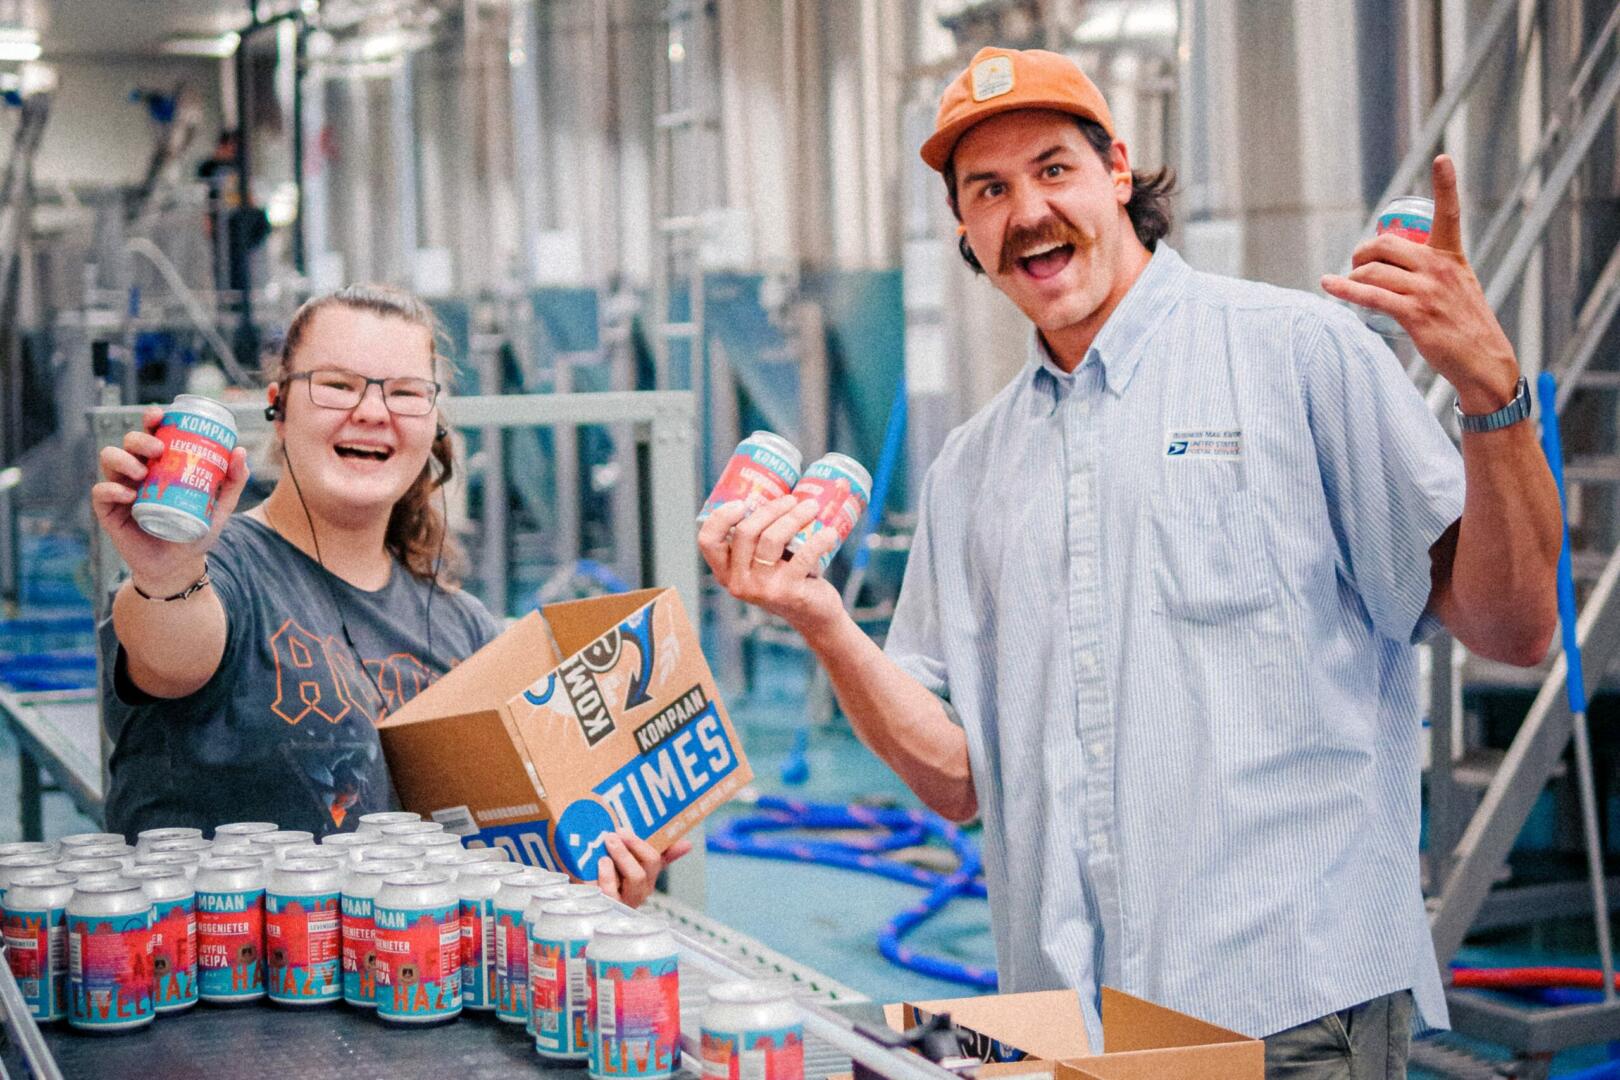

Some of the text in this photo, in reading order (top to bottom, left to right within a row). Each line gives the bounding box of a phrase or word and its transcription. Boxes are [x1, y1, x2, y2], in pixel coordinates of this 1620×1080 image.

[180, 415, 235, 448] KOMPAAN
[180, 472, 211, 494] NEIPA
[638, 689, 706, 752] KOMPAAN
[602, 713, 732, 834] TIMES
[198, 894, 244, 911] MPAAN
[375, 908, 405, 929] PAAN
[603, 1039, 669, 1073] LIVE
